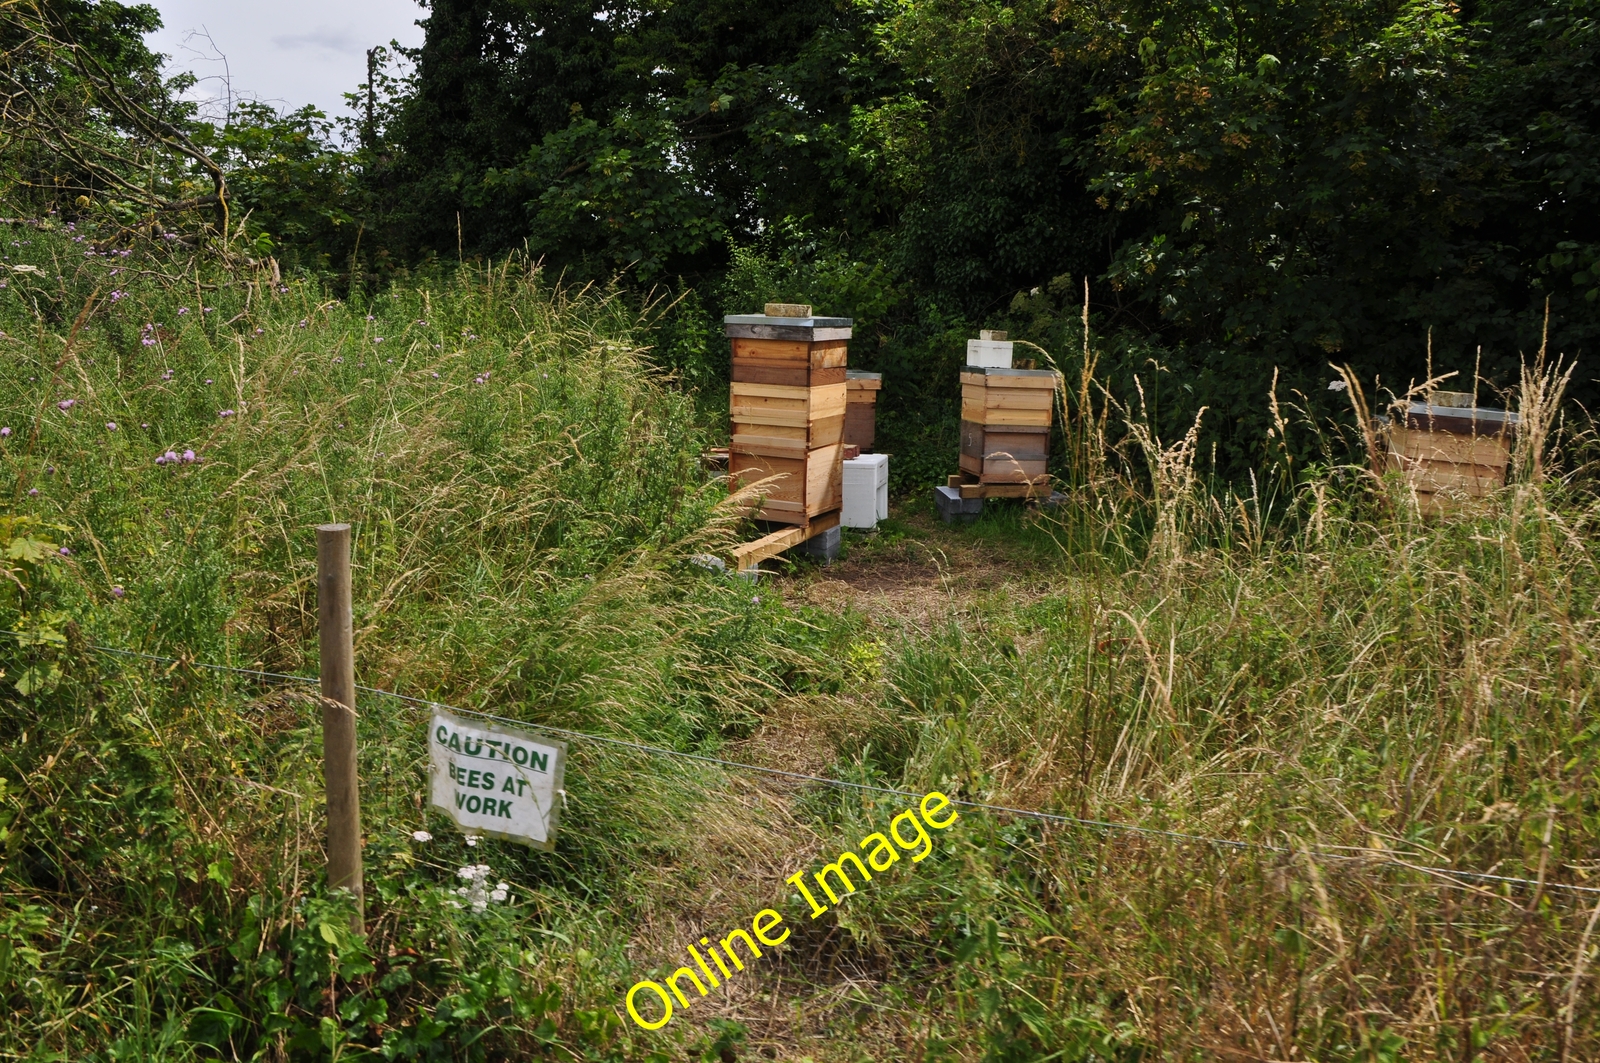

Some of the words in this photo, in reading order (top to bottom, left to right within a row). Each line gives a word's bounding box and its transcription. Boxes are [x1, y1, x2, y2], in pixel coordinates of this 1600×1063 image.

[436, 725, 549, 771] CAUTION
[448, 762, 495, 790] BEES
[501, 776, 527, 797] AT
